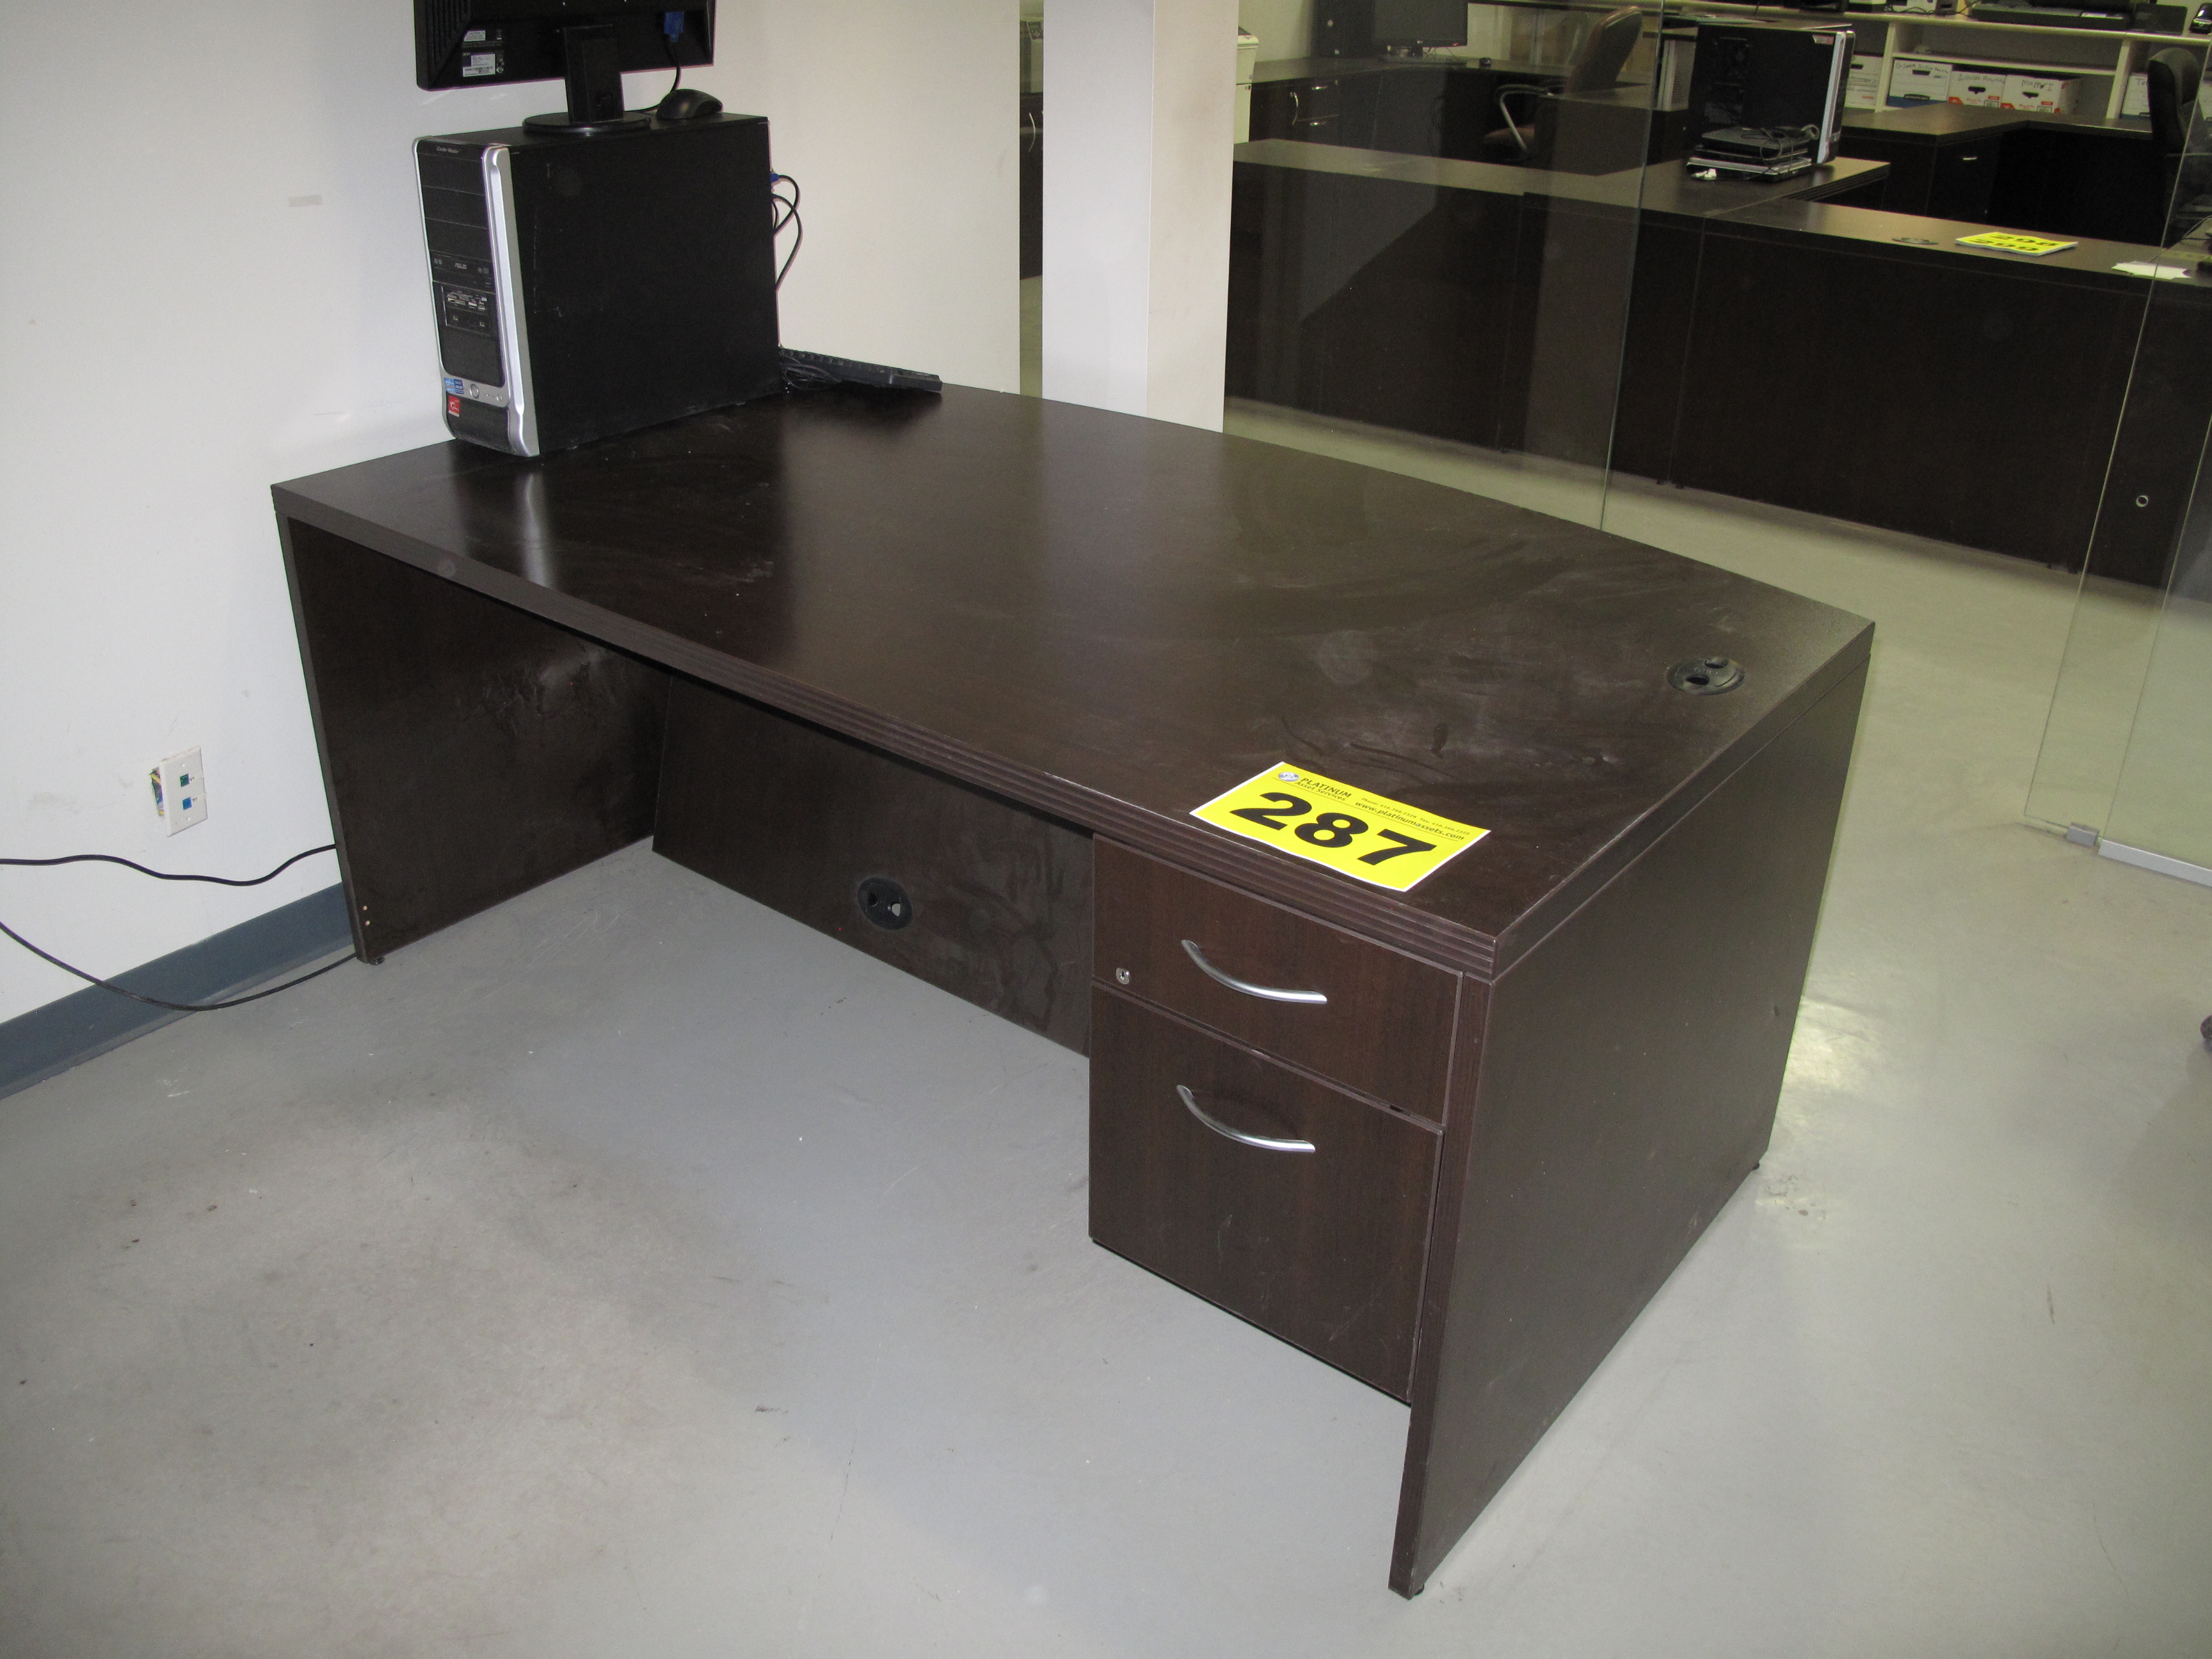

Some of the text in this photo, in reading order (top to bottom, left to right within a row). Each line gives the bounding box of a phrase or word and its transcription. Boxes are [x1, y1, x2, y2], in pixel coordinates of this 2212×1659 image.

[1295, 781, 1347, 801] Asset Services
[1301, 778, 1352, 798] PLATINUM
[1229, 792, 1437, 865] 287
[1355, 801, 1464, 841] www.platinumassets.com
